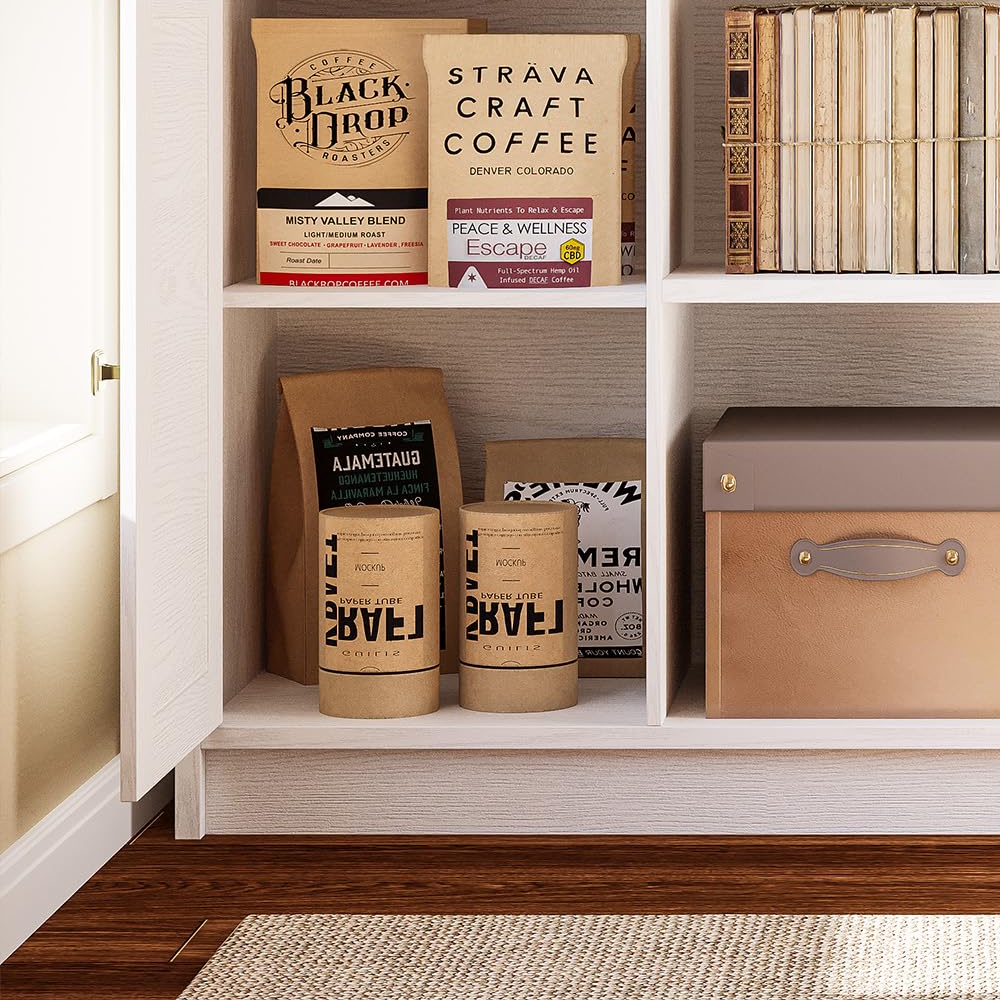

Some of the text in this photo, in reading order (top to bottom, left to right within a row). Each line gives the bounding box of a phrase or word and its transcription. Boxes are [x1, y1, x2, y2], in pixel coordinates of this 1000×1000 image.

[309, 56, 377, 71] COFFEE
[448, 62, 594, 85] STRÄVA
[272, 75, 412, 125] BLACK
[457, 97, 585, 119] CRAFT
[298, 106, 410, 151] DROP
[322, 139, 391, 162] ROASTERS
[444, 132, 598, 155] COFFEE
[469, 167, 574, 176] DENVER COLORADO
[286, 216, 406, 225] MISTY VALLEY BLEND
[560, 206, 585, 215] Escape
[452, 222, 587, 235] PEACE & WELLNESS
[466, 238, 547, 260] Escape
[563, 251, 582, 260] CBD
